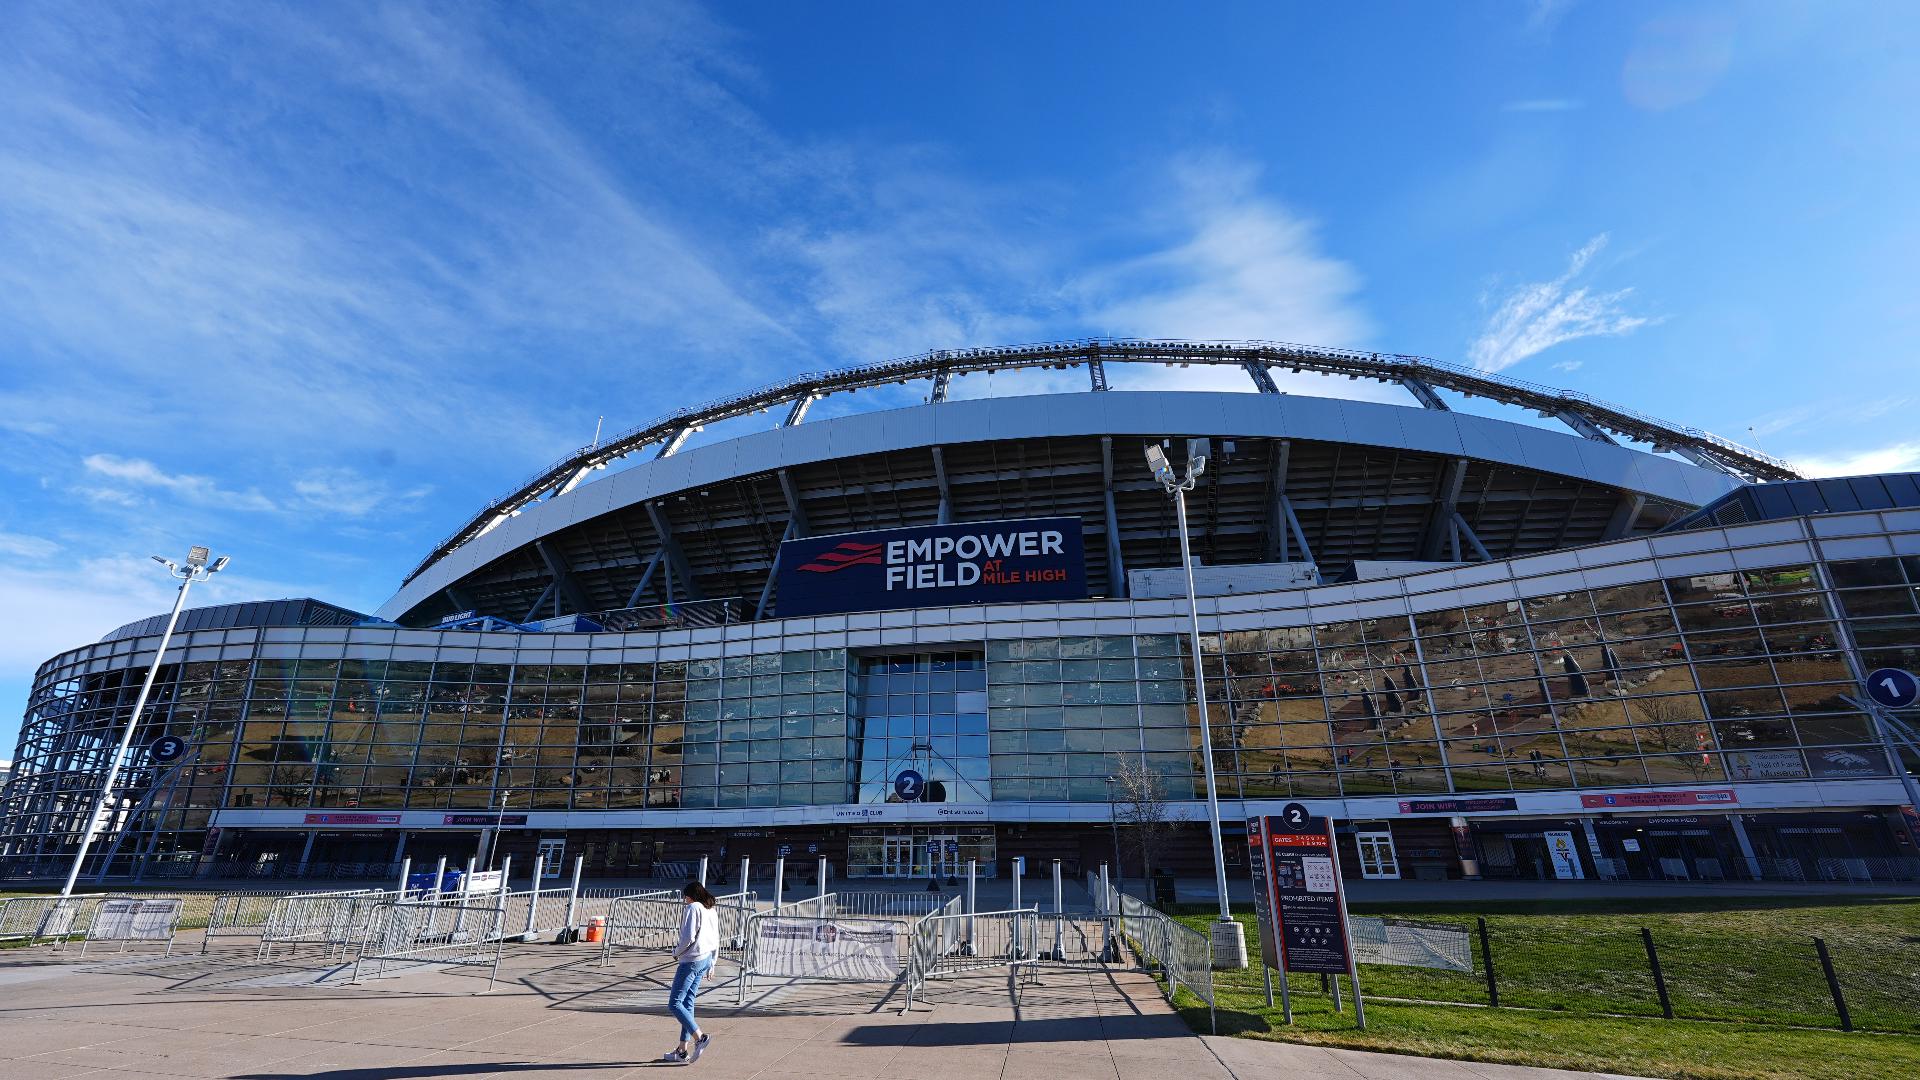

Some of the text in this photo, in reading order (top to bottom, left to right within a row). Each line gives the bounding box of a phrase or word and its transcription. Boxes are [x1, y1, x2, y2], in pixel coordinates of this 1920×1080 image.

[886, 530, 1065, 565] EMPOWER
[983, 560, 1003, 572] AT
[886, 562, 981, 591] FIELD
[983, 569, 1067, 585] MILE HIGH
[454, 611, 472, 620] LIGHT
[1879, 677, 1901, 698] 1
[160, 741, 177, 756] 3
[1760, 769, 1808, 778] Museum
[903, 776, 915, 794] 2
[1415, 803, 1435, 811] JOIN
[1290, 809, 1302, 823] 2
